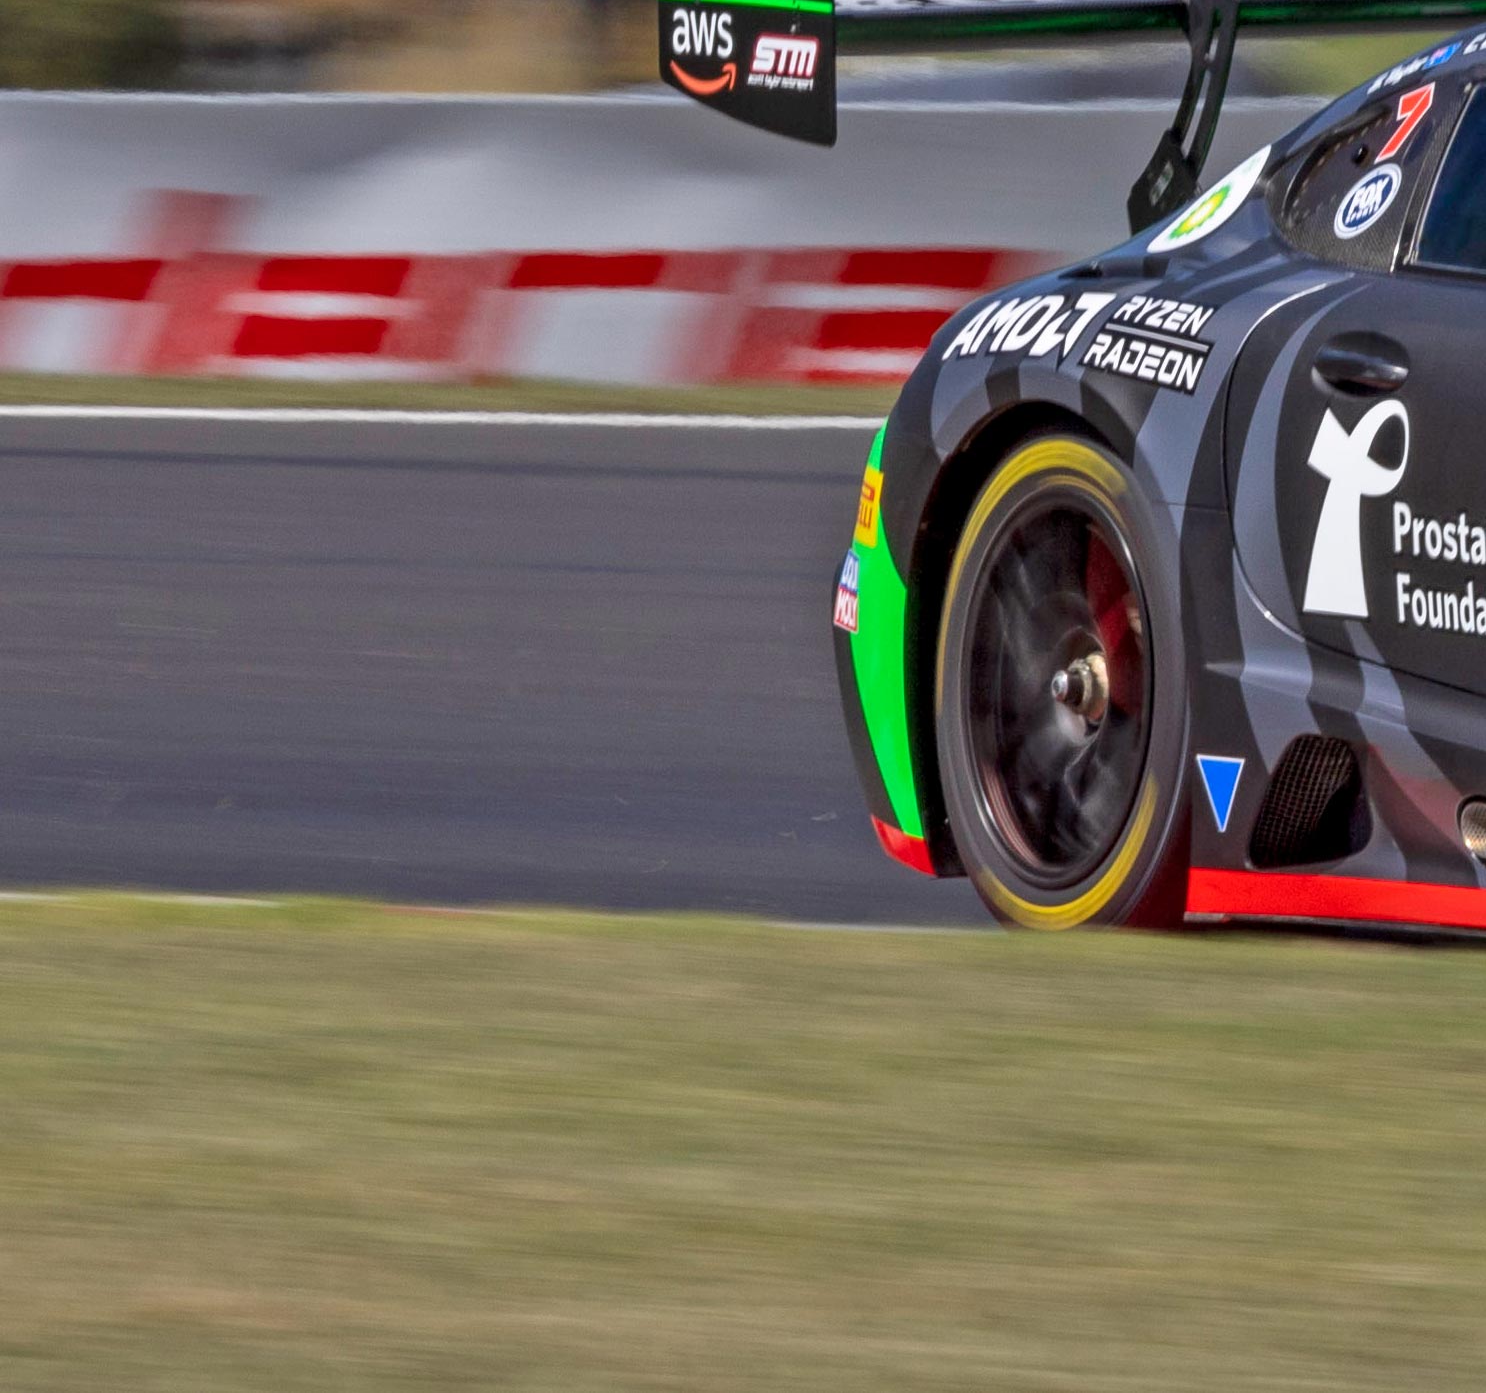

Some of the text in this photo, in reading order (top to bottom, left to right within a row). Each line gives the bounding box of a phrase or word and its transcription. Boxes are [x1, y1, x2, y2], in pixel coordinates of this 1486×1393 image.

[672, 8, 734, 58] aws
[751, 35, 819, 78] STM
[1374, 82, 1437, 164] 7
[1344, 175, 1390, 225] FOX
[942, 294, 1065, 361] AMD
[1113, 295, 1215, 337] RYZEN
[1082, 332, 1204, 392] RADEON
